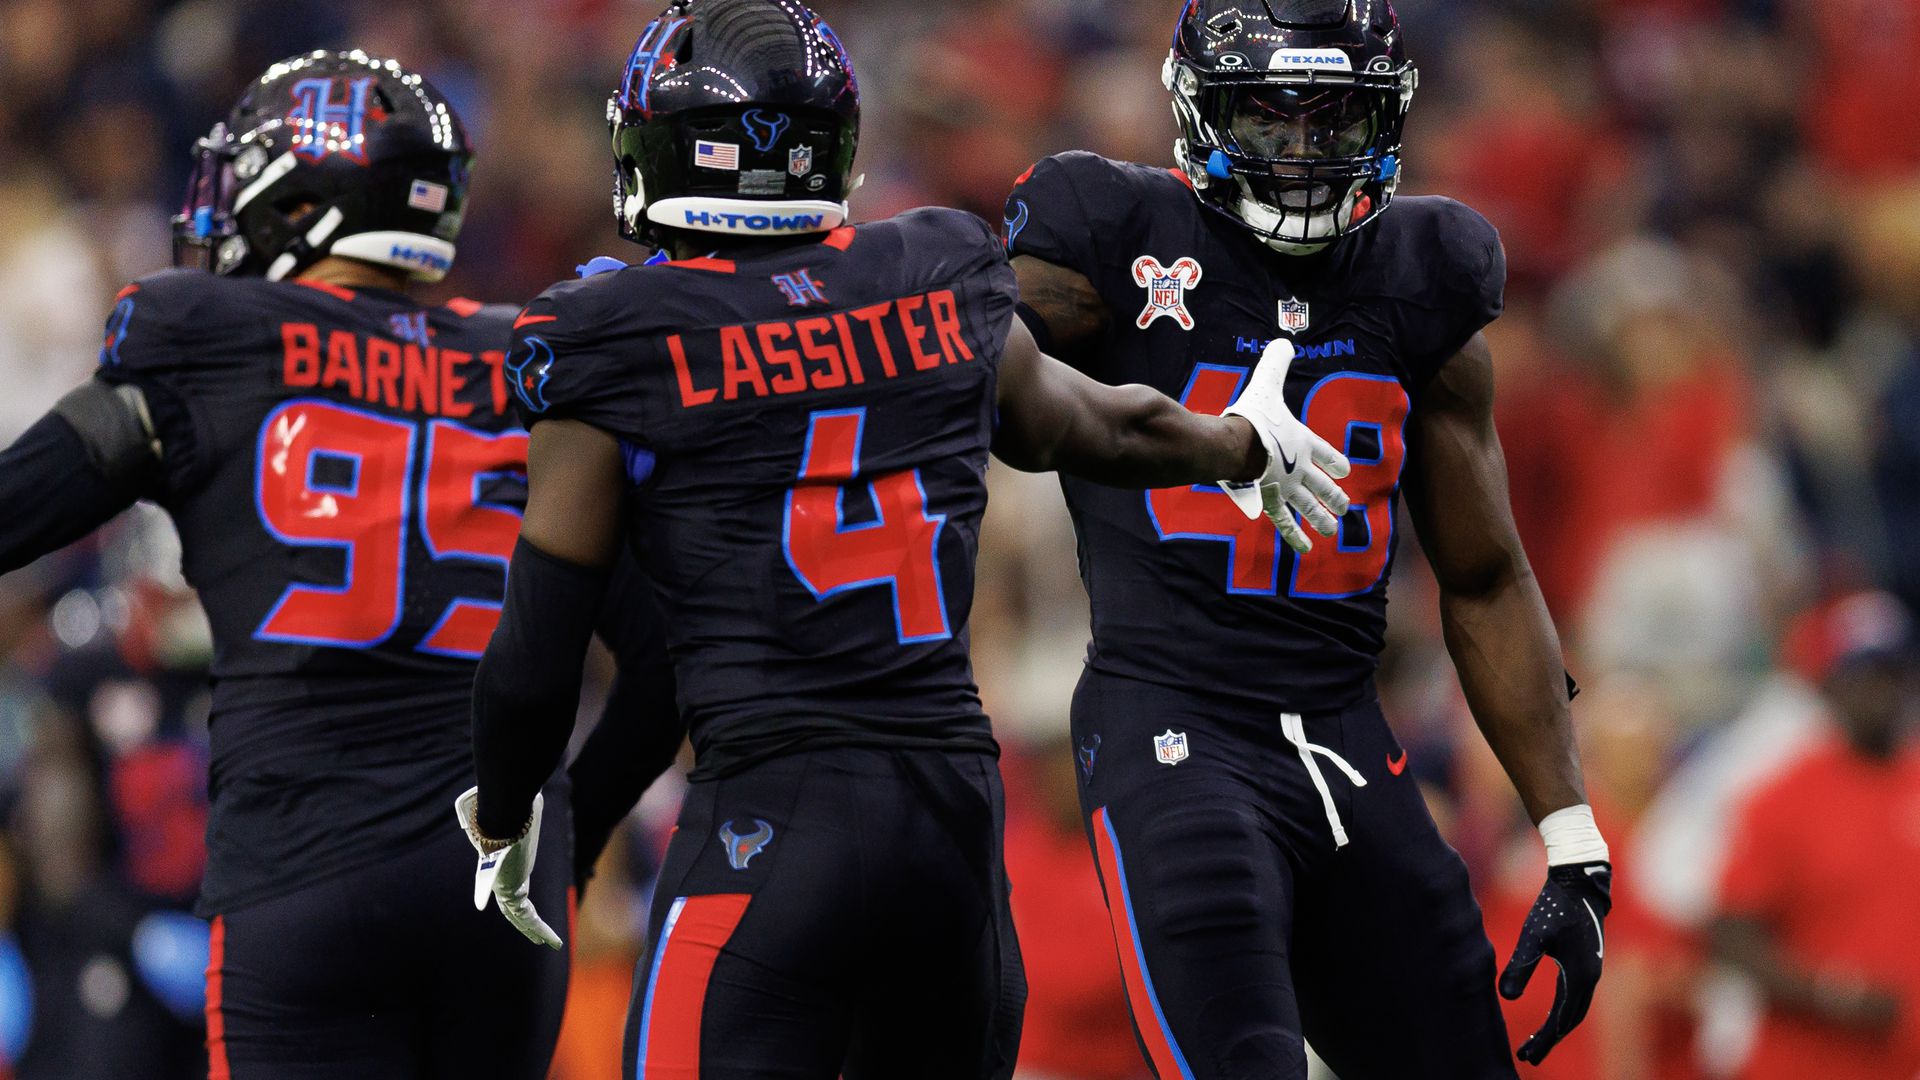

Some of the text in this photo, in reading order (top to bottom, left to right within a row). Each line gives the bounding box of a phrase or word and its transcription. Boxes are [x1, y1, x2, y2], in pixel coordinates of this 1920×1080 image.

[1281, 55, 1345, 64] TEXANS
[1155, 290, 1178, 306] NFL
[1285, 312, 1305, 327] NFL
[666, 289, 975, 408] LASSITER
[1145, 362, 1411, 600] 48
[251, 396, 531, 660] 95
[782, 406, 952, 645] 4
[1162, 745, 1184, 759] NFL
